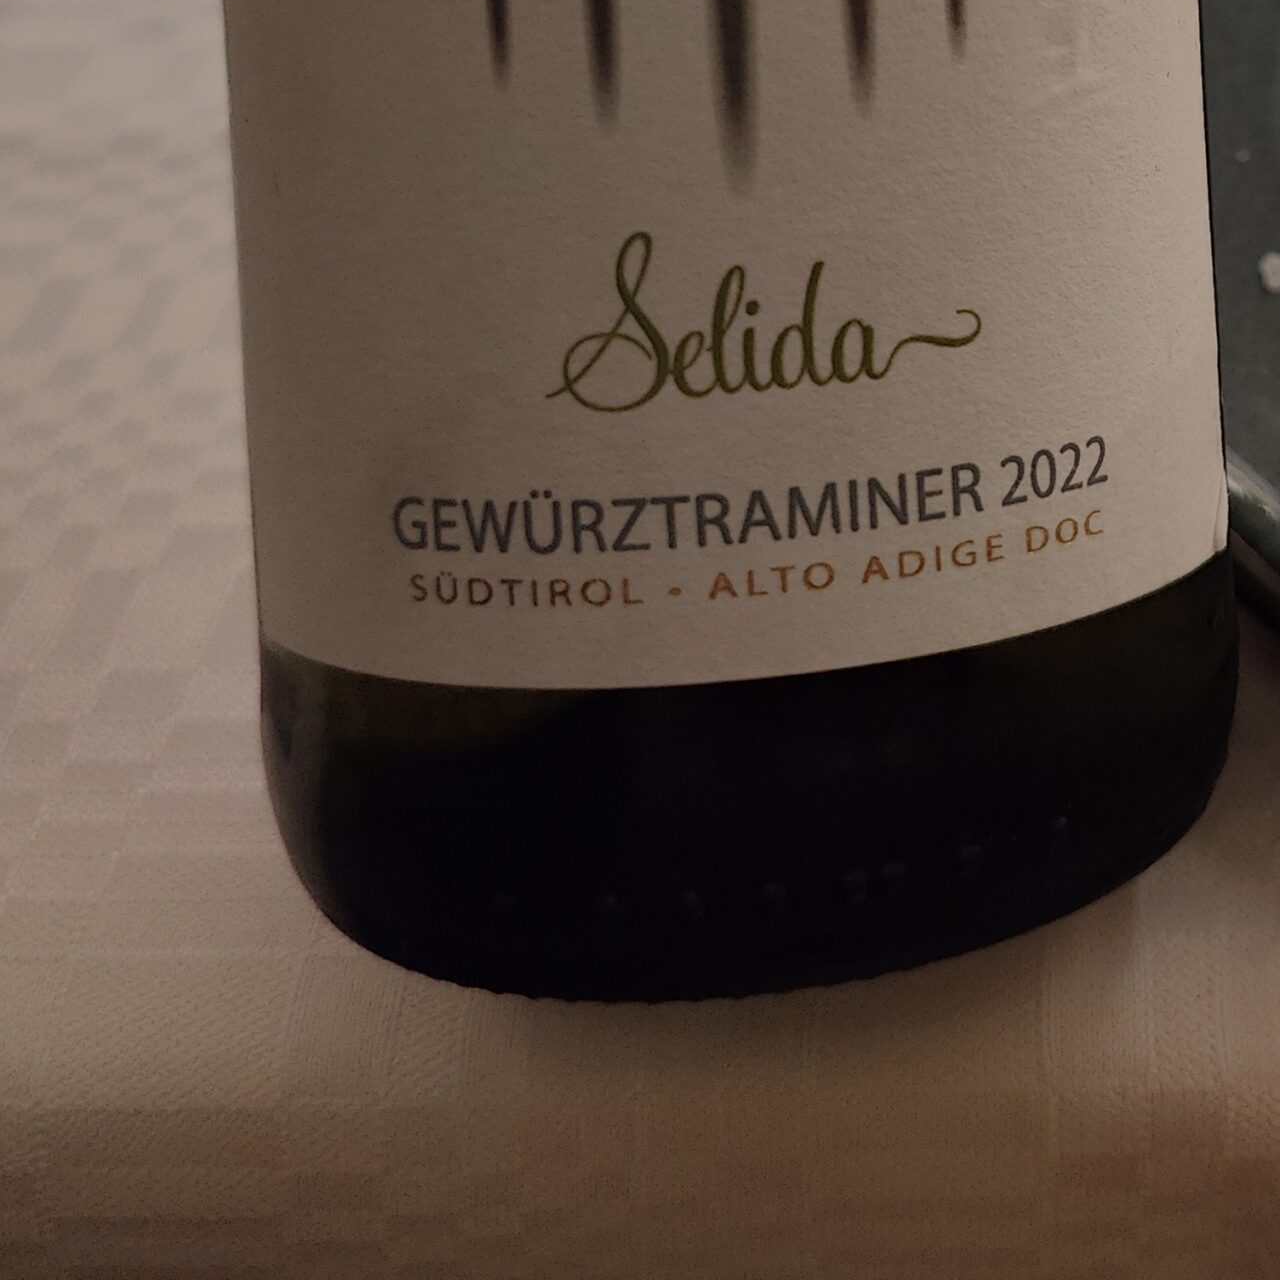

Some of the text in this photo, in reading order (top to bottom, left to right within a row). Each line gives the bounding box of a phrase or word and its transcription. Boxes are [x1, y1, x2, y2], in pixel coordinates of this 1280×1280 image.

[545, 231, 981, 412] Selida
[393, 435, 1110, 555] GEWÜRZTRAMINER 2022
[410, 510, 1104, 608] SÜDTIROL ALTO ADIGE DOC
